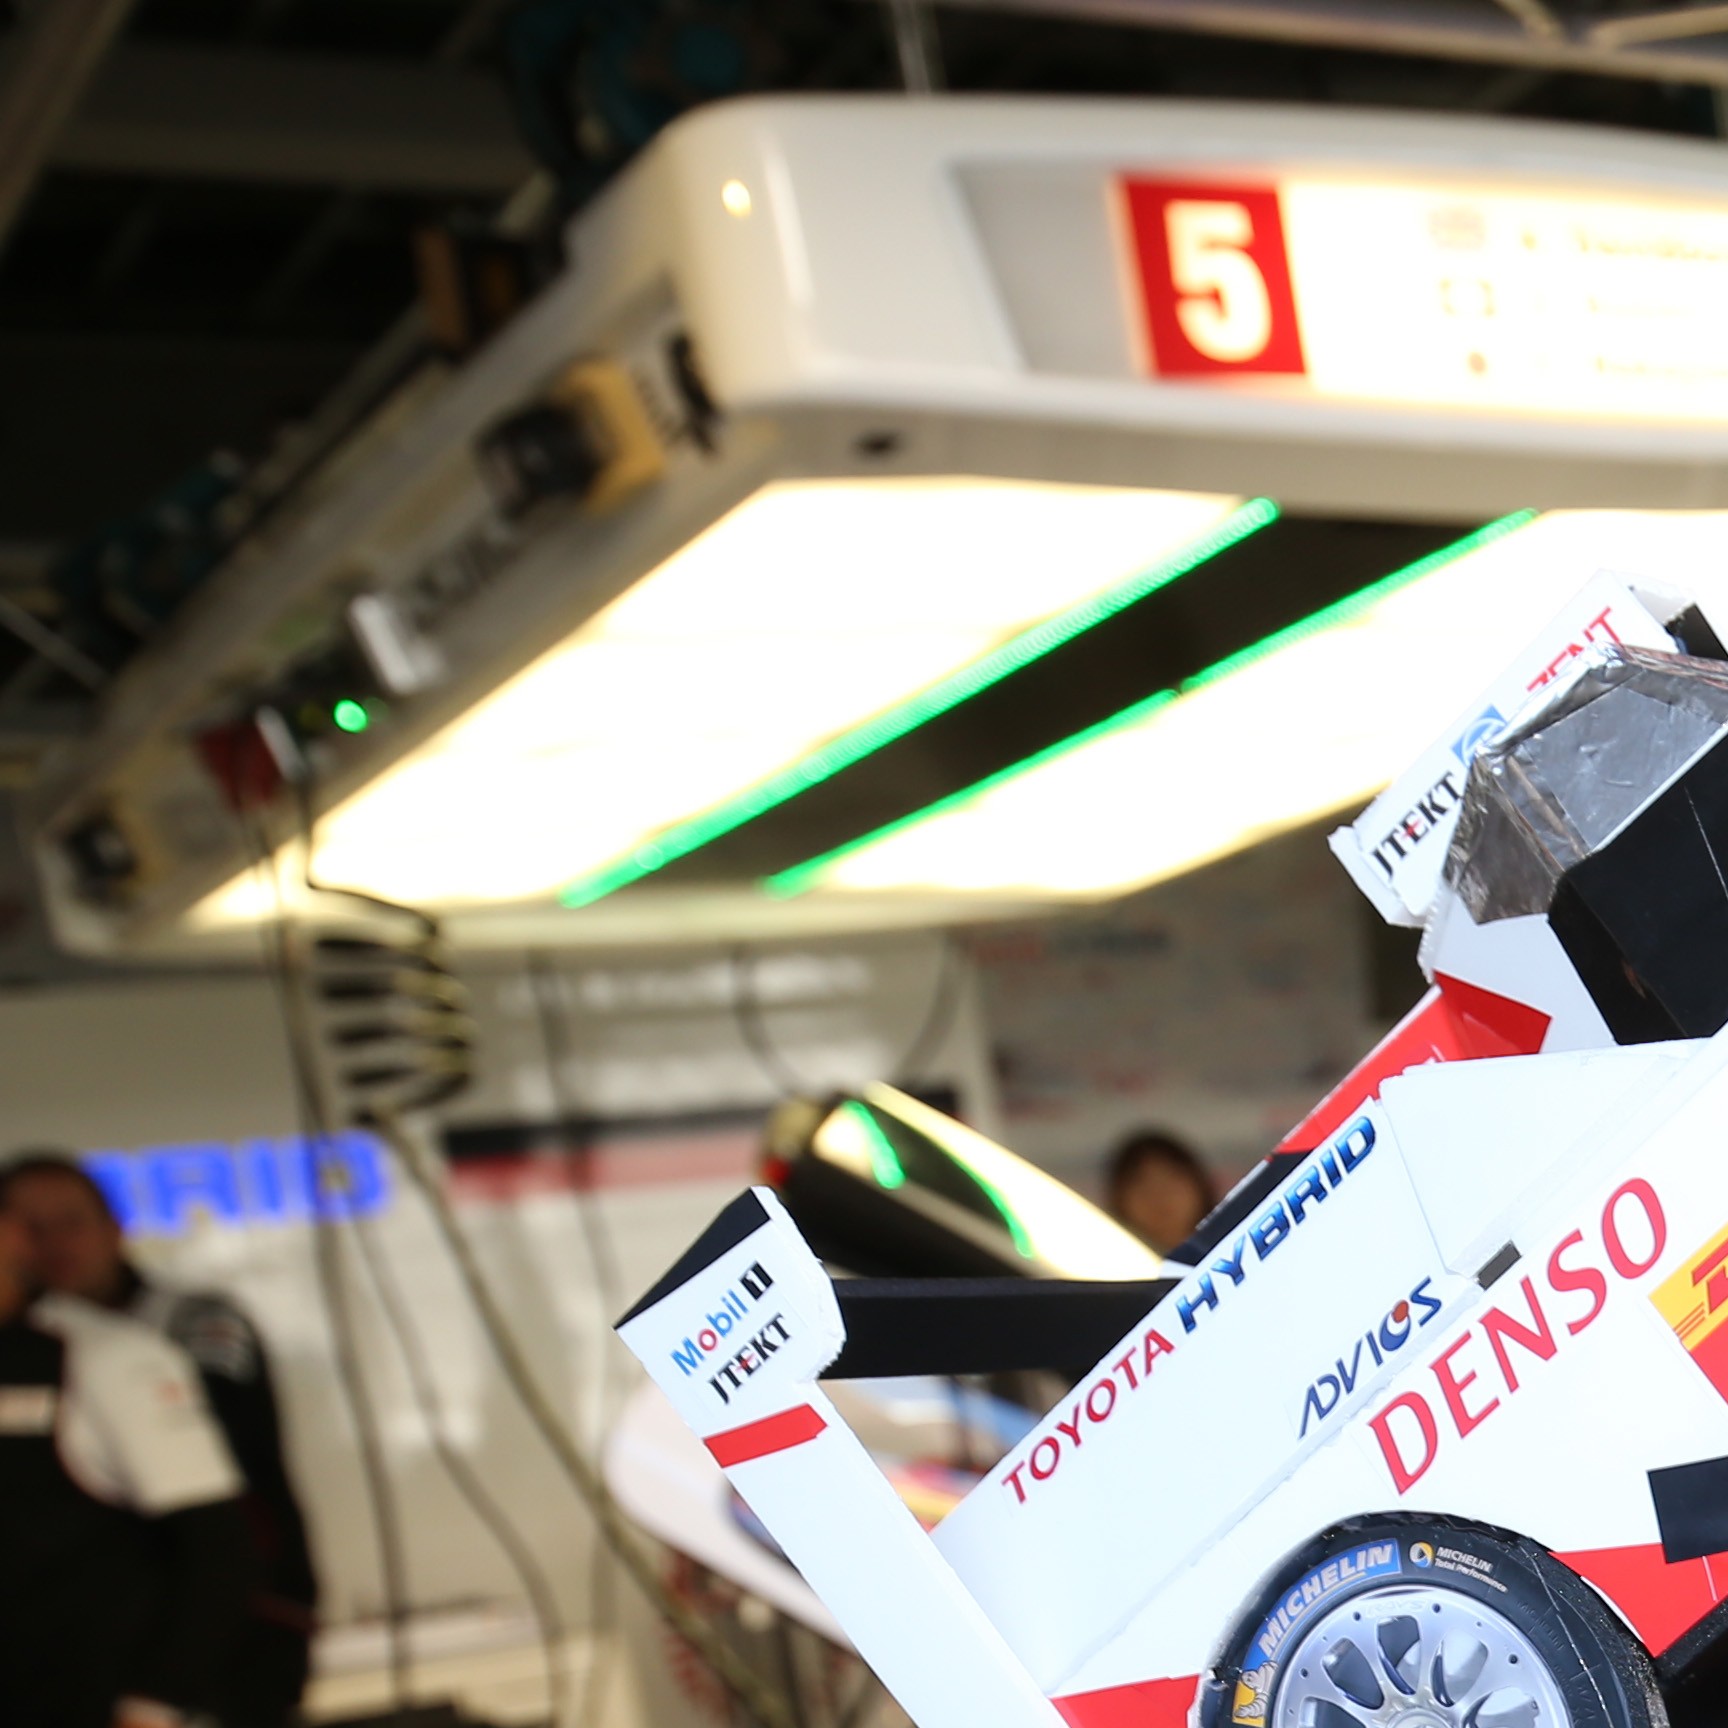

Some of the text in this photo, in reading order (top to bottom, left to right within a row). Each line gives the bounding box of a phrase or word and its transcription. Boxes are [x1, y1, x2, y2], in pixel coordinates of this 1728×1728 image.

[1162, 200, 1275, 362] 5
[1370, 772, 1463, 877] JTEKT
[669, 1260, 773, 1376] Mobil 1
[707, 1312, 791, 1404] JTEKT
[1001, 1115, 1376, 1505] TOYOTA HYBRID
[1297, 1276, 1441, 1440] ADVICS
[1366, 1177, 1667, 1495] DENSO
[1259, 1544, 1394, 1657] MICHELIN
[1437, 1547, 1493, 1573] MICHELIN
